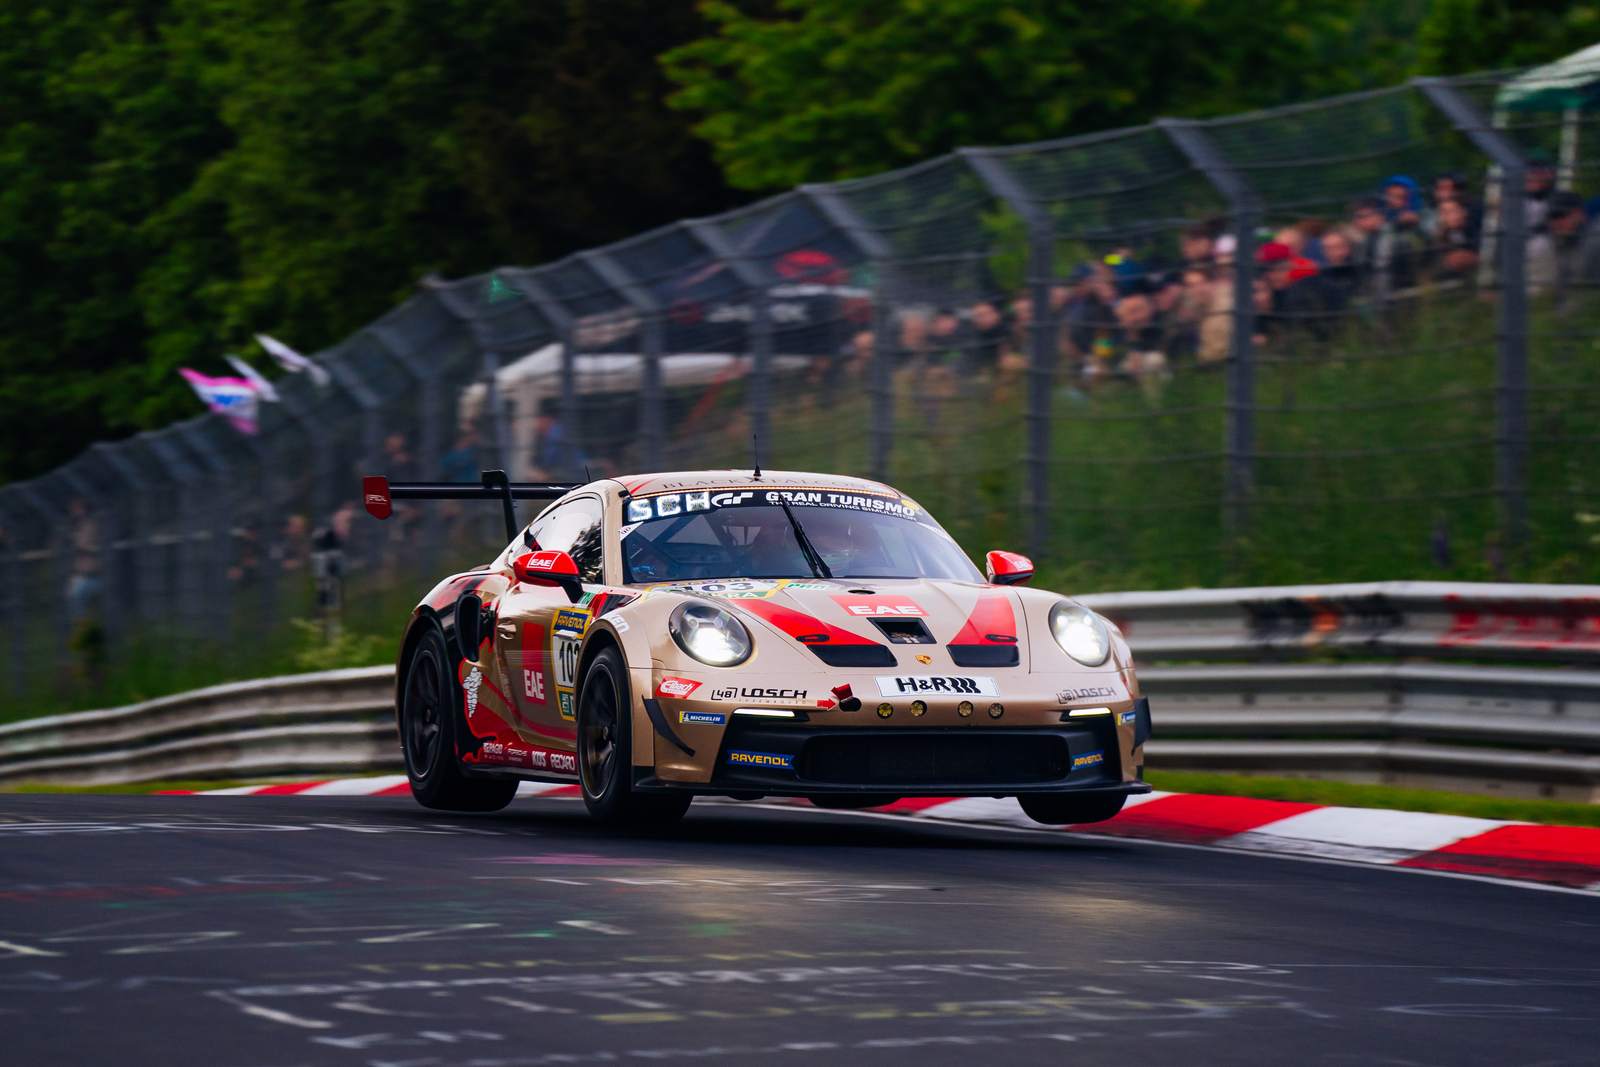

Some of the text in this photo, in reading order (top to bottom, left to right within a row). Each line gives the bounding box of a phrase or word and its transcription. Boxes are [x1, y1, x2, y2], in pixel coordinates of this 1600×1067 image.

[629, 493, 710, 522] SCH
[765, 491, 917, 517] GRAN TURISMO
[820, 502, 862, 511] DRIVING
[530, 558, 553, 567] EAE
[847, 605, 923, 615] EAE
[523, 669, 545, 700] EAE
[741, 688, 808, 699] LOSCH
[1073, 687, 1117, 698] LOSCH
[550, 753, 576, 771] RECARO
[731, 752, 789, 766] RAVENOL
[1073, 754, 1104, 767] RAVENOL
